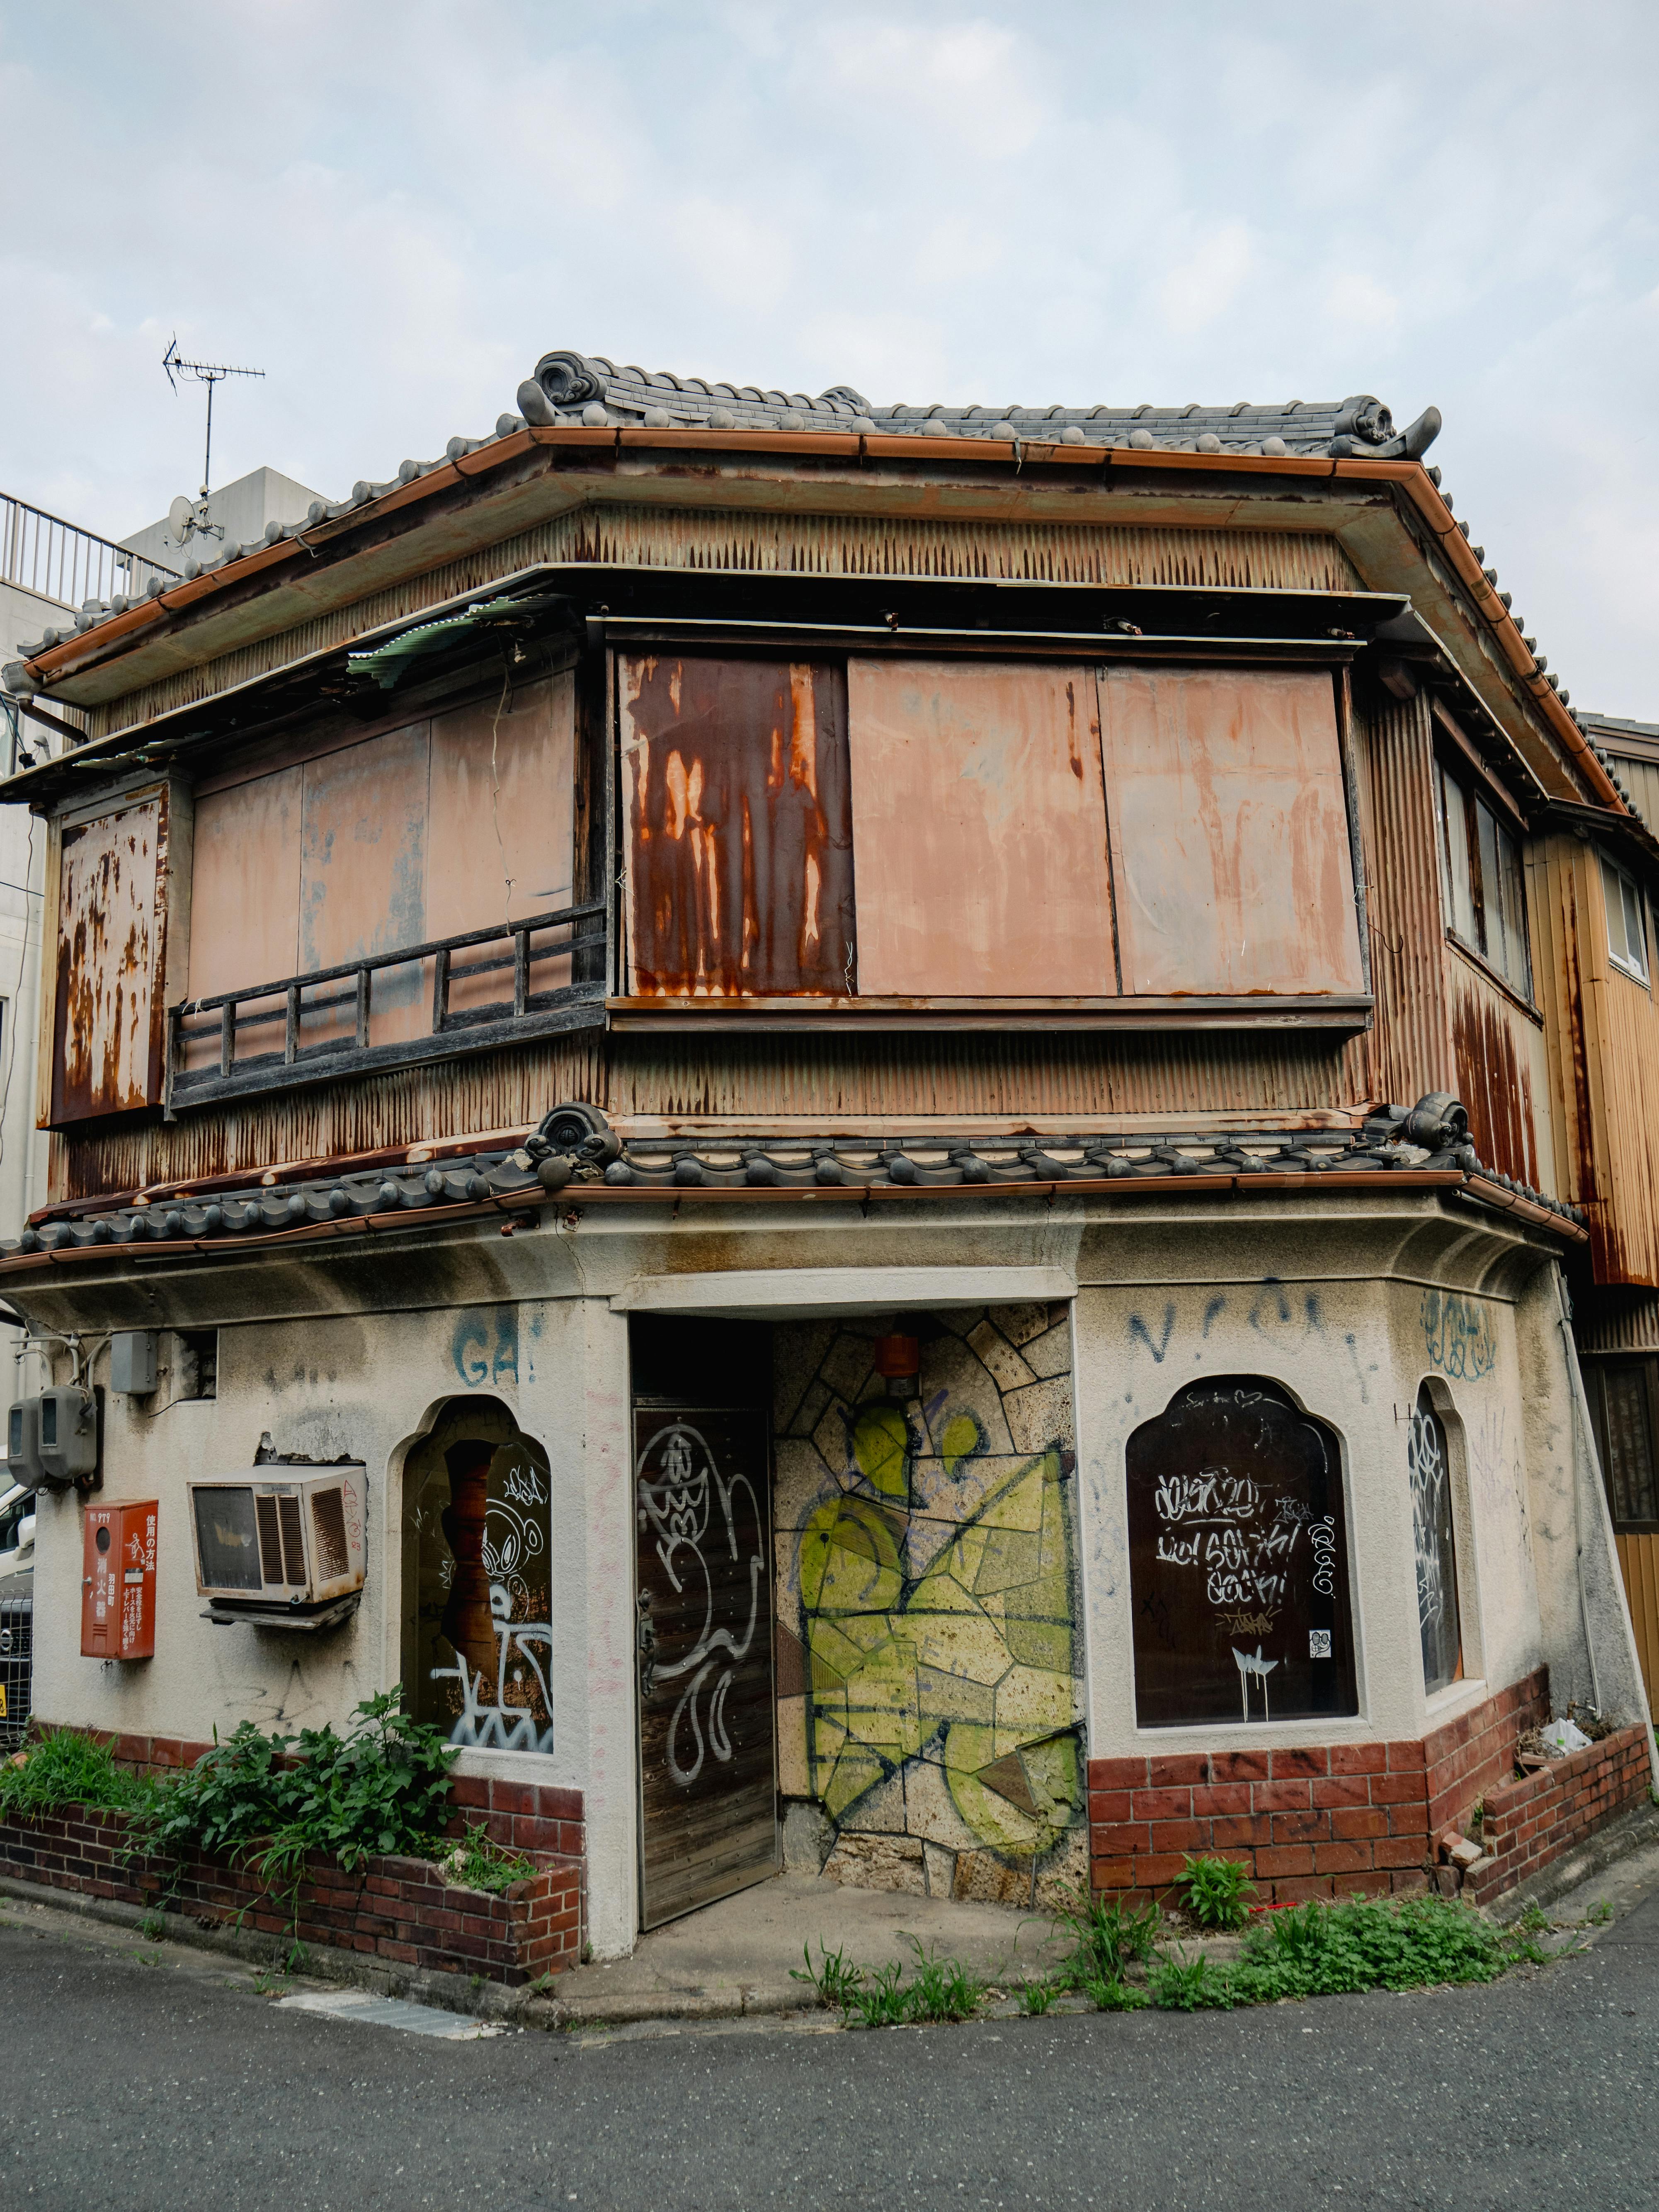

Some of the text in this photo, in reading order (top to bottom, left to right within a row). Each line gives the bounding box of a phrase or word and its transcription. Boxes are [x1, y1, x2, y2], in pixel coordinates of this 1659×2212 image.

[98, 1513, 110, 1523] 979
[146, 1515, 156, 1571] 使用の方法
[96, 1558, 107, 1617] 消火器
